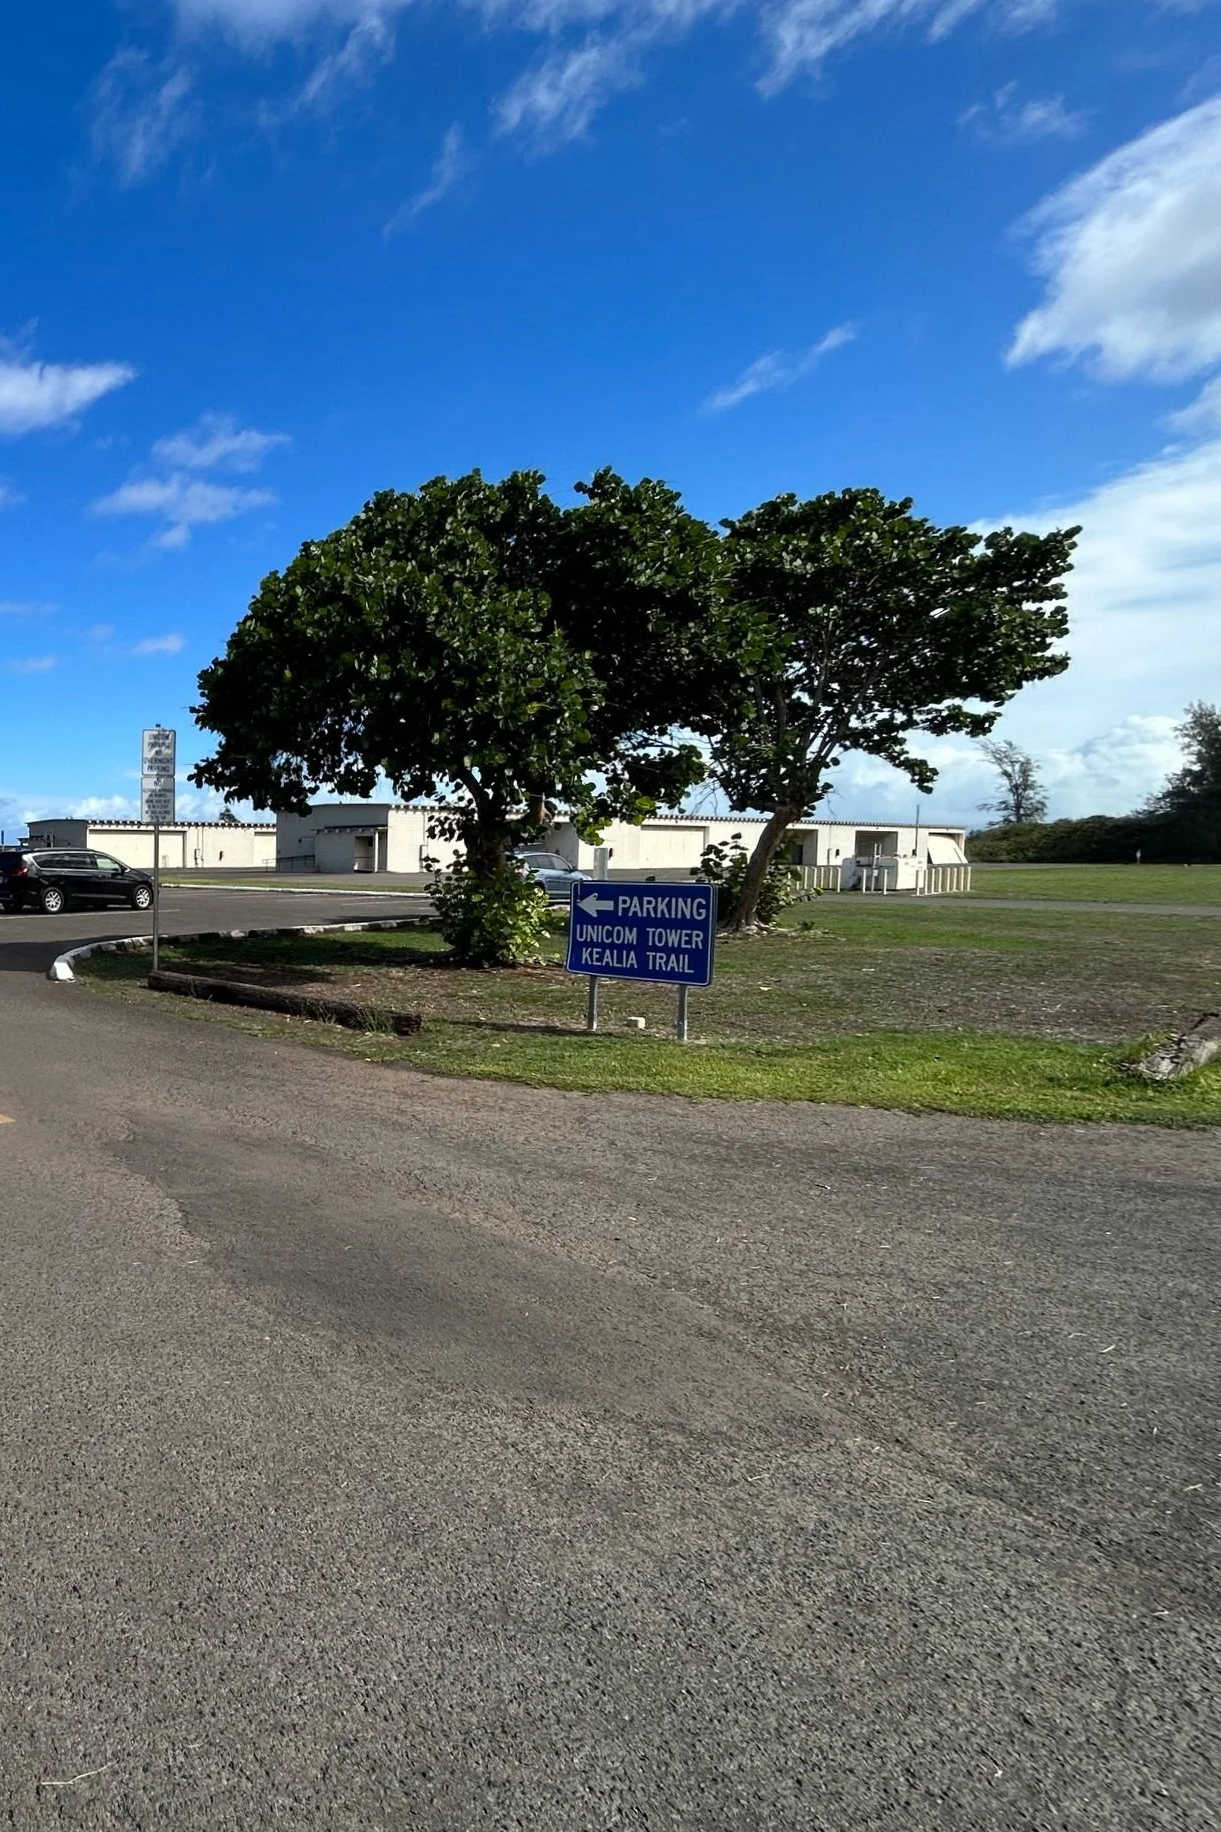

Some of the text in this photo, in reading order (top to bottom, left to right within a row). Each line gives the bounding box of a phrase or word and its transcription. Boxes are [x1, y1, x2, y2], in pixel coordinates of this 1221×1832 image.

[153, 780, 163, 788] NO
[618, 896, 706, 920] PARKING
[576, 924, 703, 949] UNICOM TOWER
[582, 947, 694, 973] KEALIA TRAIL
